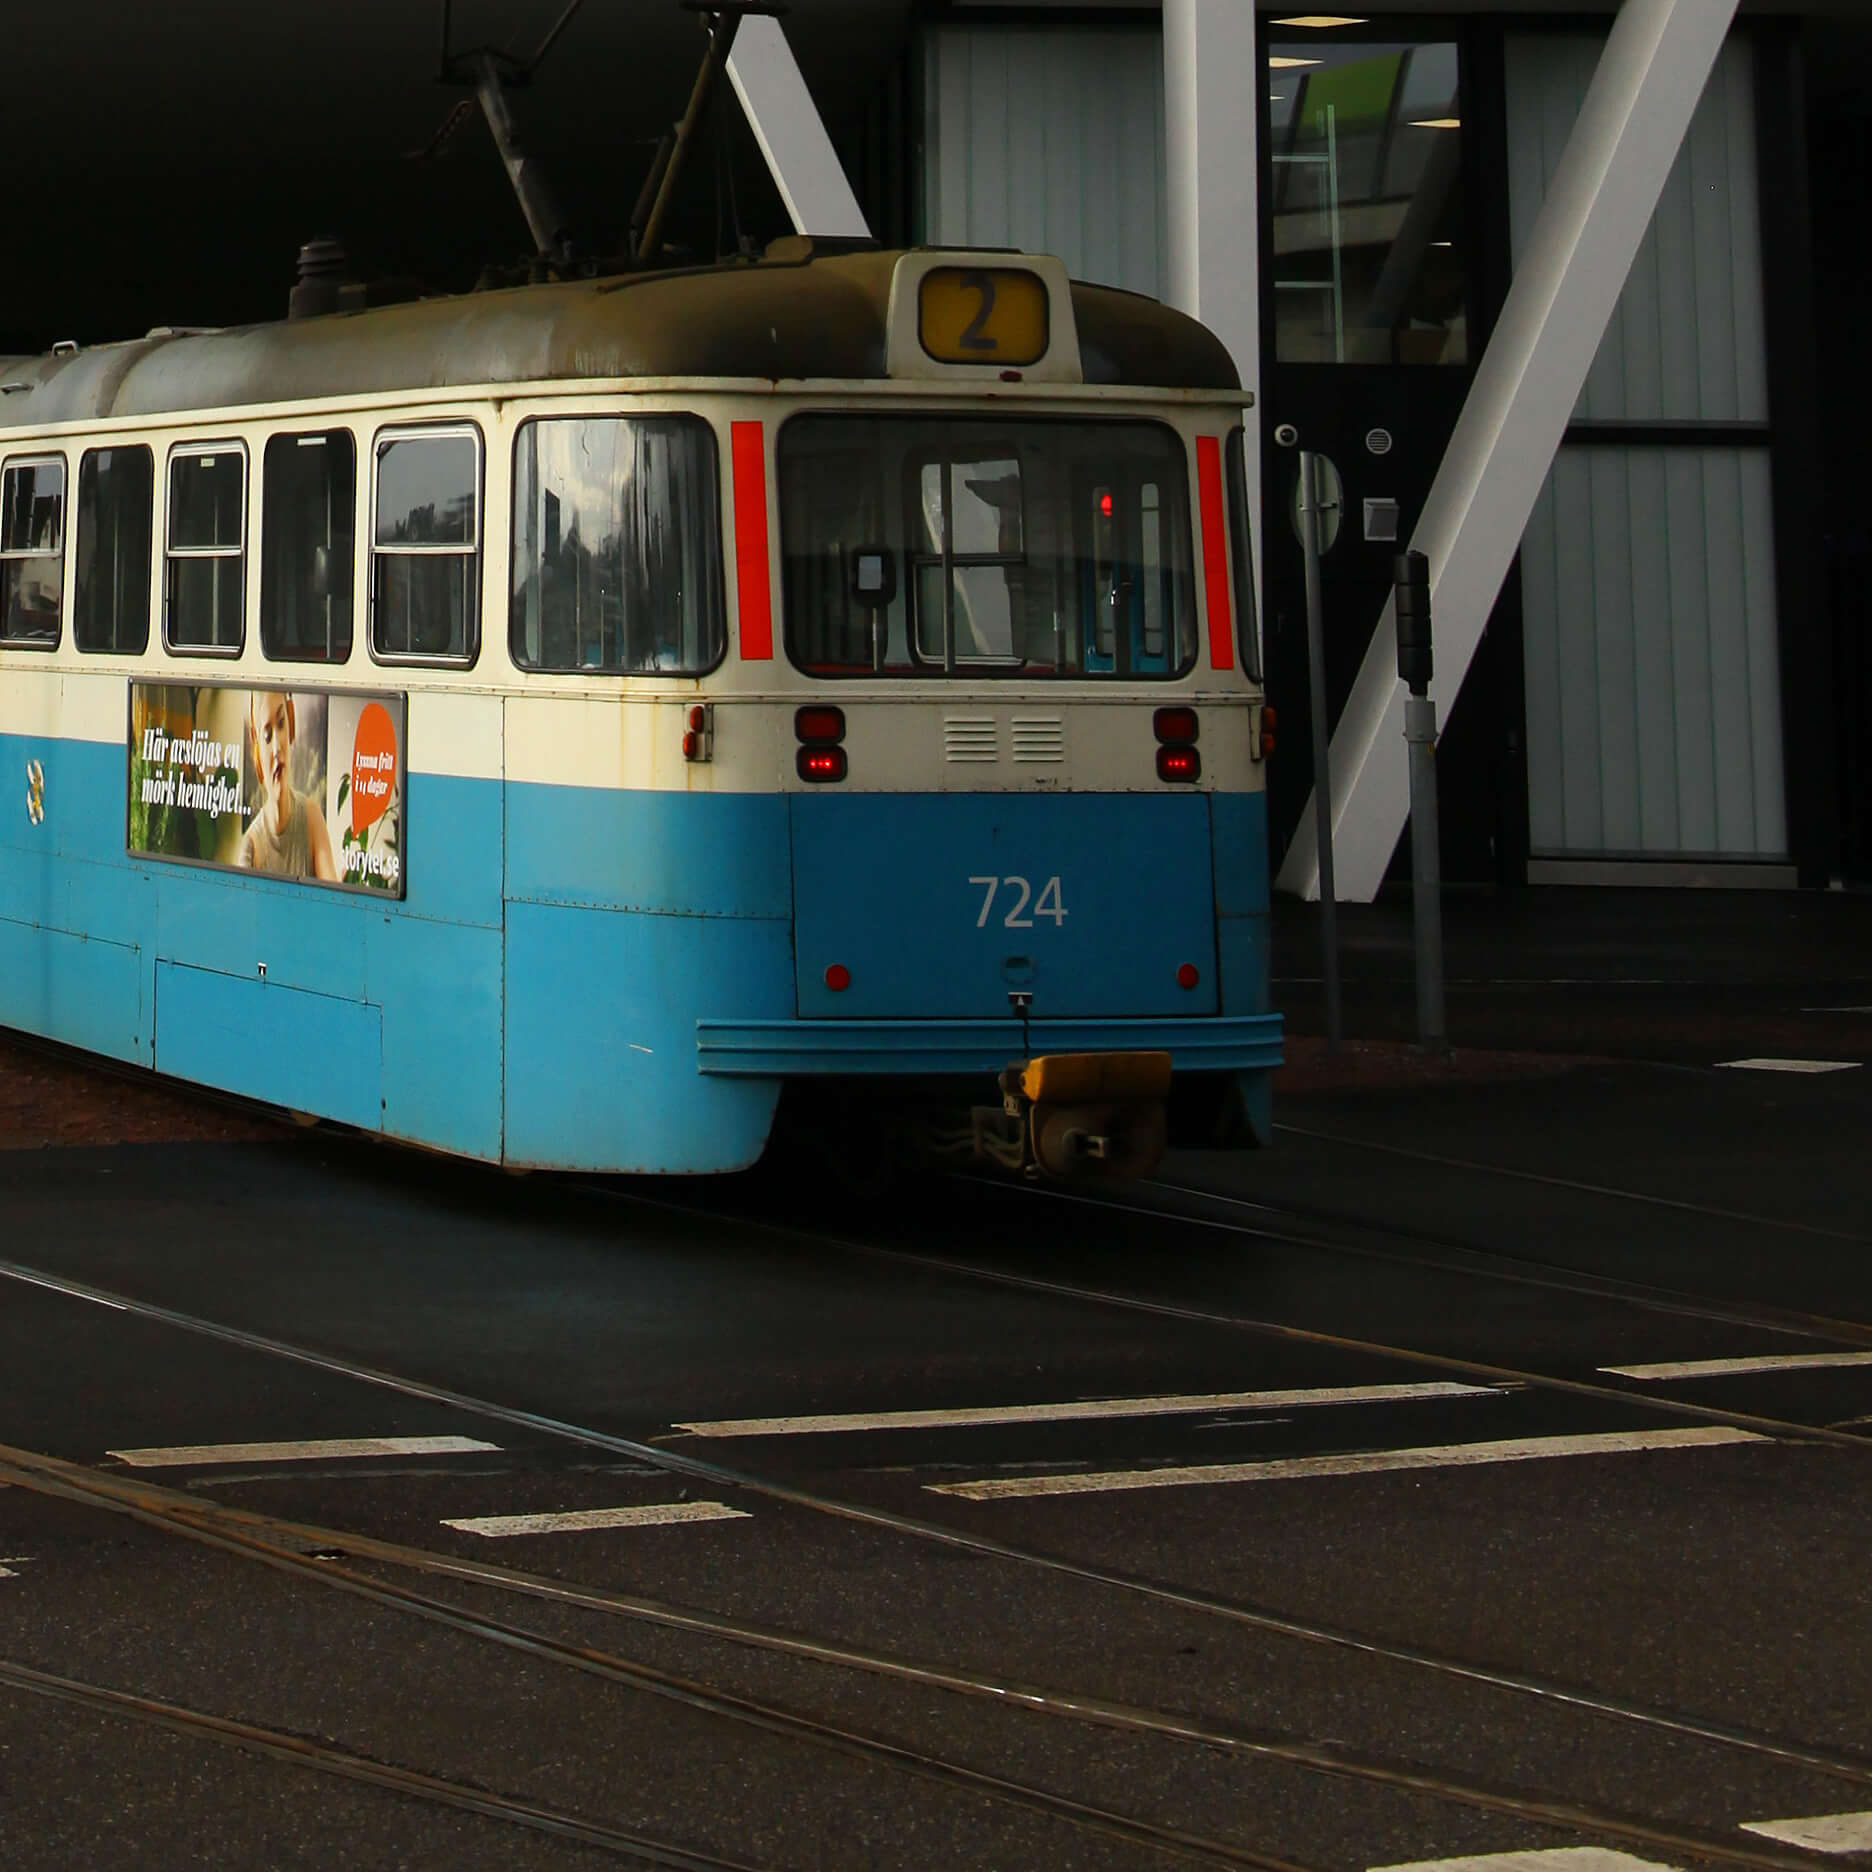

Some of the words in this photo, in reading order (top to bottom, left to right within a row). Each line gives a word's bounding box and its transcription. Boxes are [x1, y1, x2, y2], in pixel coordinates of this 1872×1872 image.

[959, 273, 997, 349] 2
[142, 727, 169, 762] Här
[170, 729, 222, 774] avslöjas
[224, 743, 240, 769] en
[141, 769, 176, 807] mörk
[340, 845, 400, 881] torytel.se
[968, 875, 1069, 928] 724
